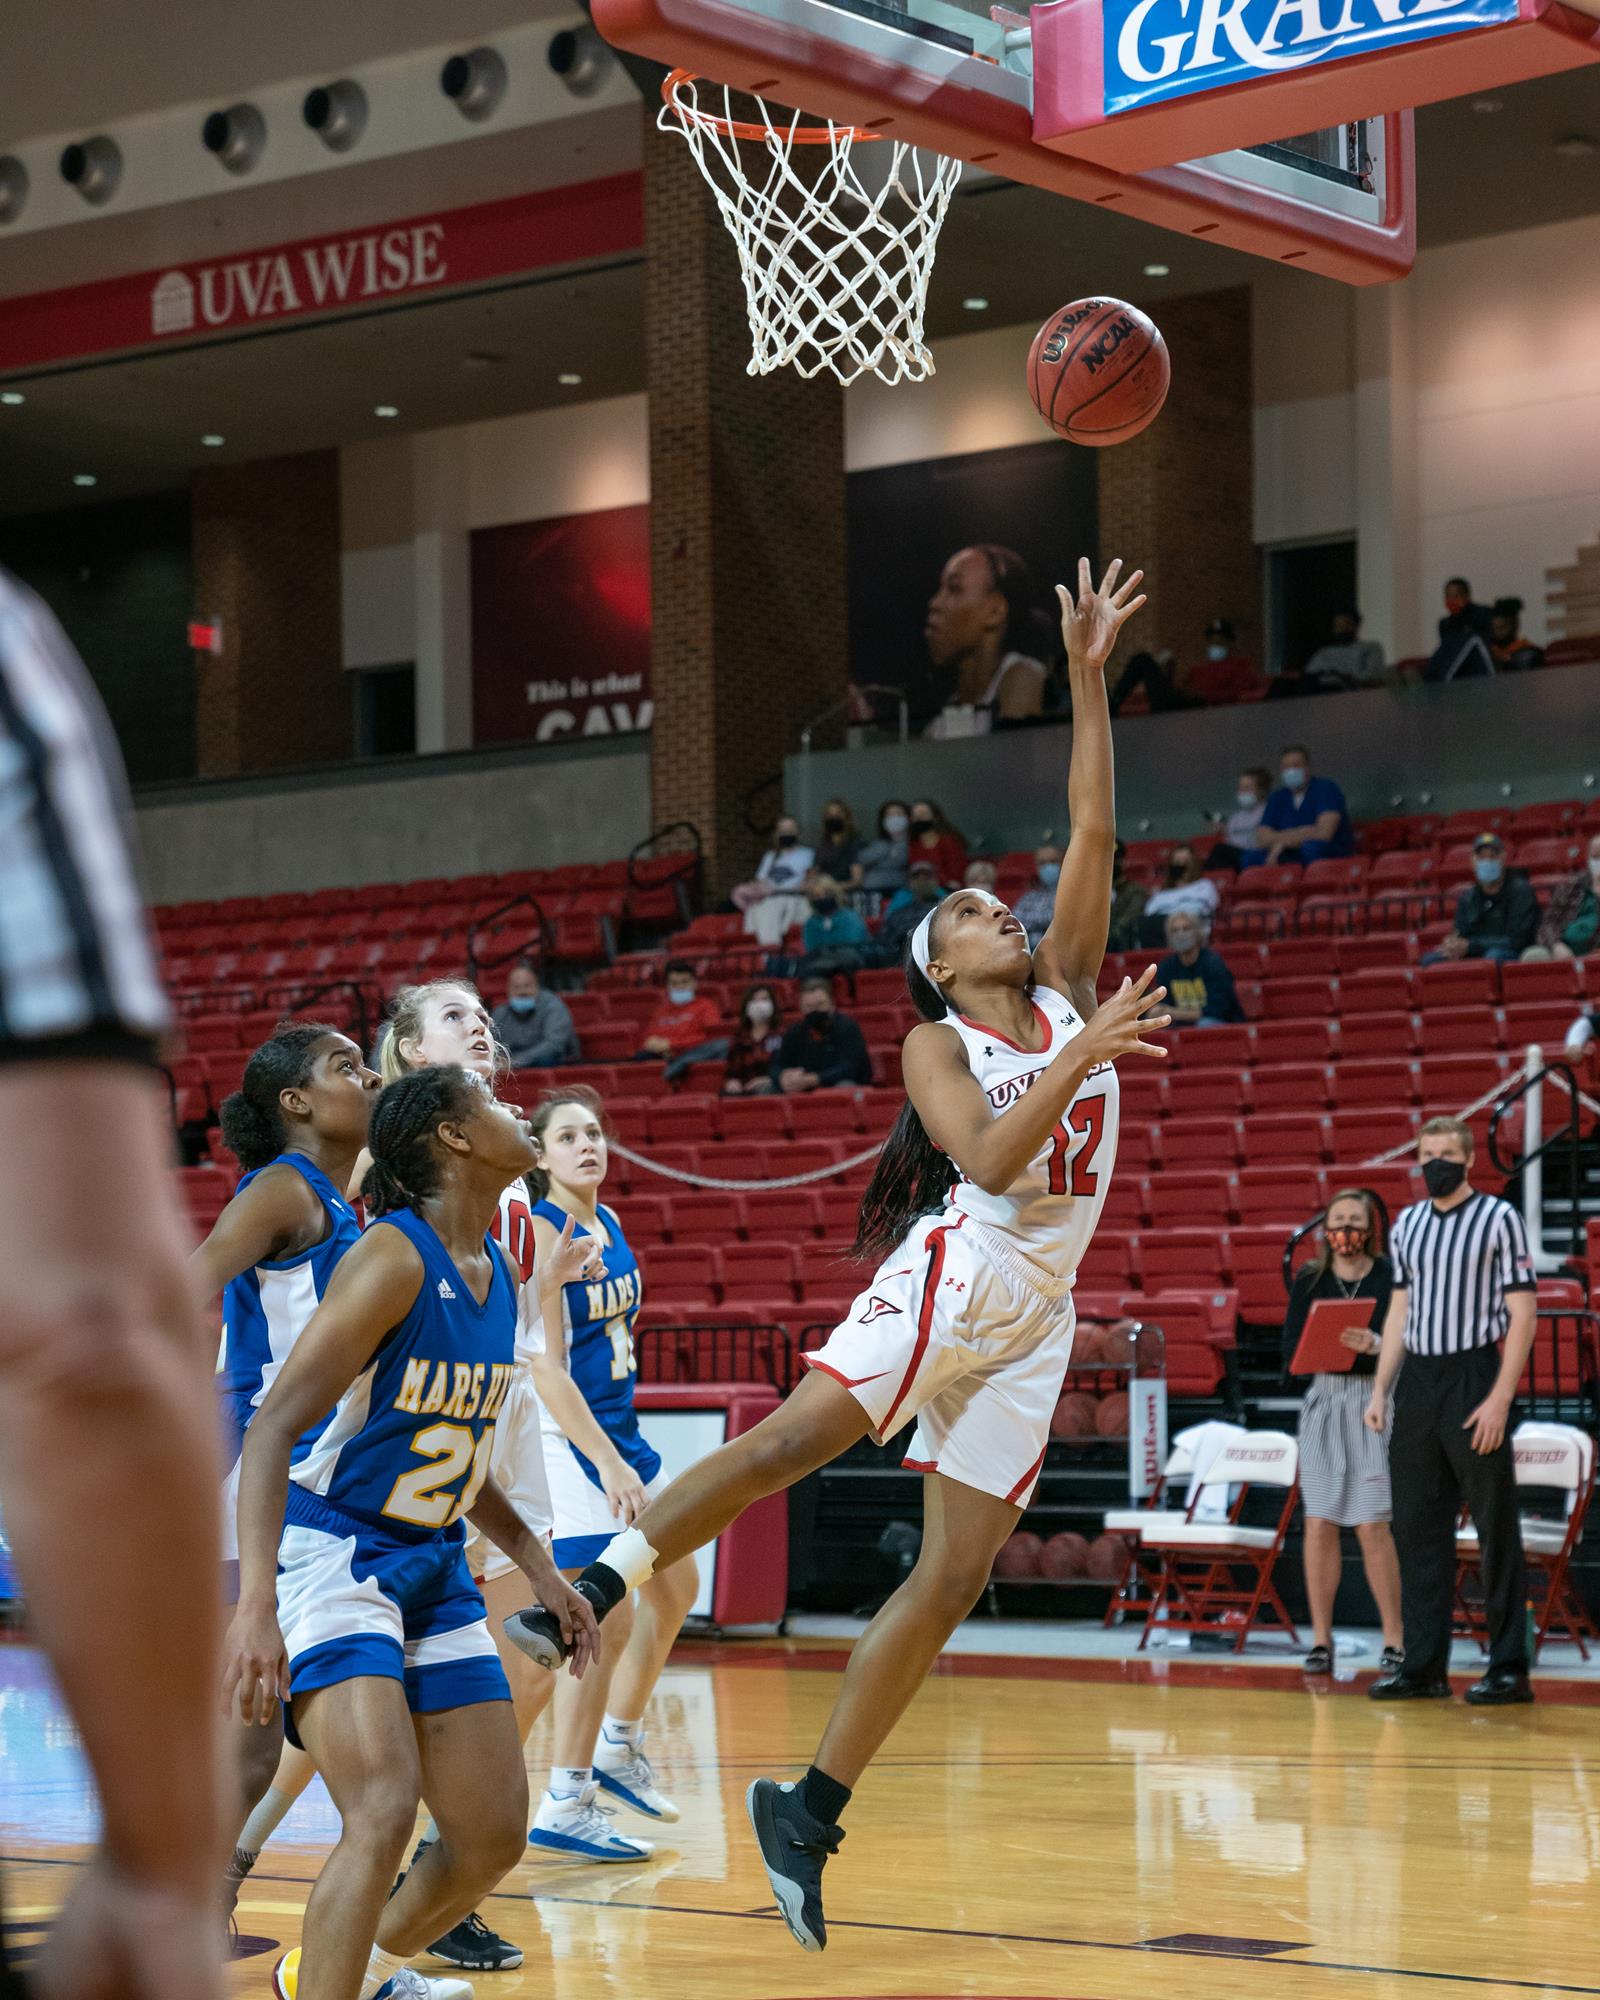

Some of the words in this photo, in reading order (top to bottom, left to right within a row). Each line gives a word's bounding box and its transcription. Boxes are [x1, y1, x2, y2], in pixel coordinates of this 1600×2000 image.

[1118, 0, 1467, 82] GRA
[199, 253, 302, 325] UVA
[303, 223, 448, 305] WISE
[1040, 299, 1112, 364] Wilso
[1082, 316, 1137, 375] NCAA
[527, 678, 568, 704] This
[570, 676, 589, 698] is
[591, 671, 642, 696] what
[1048, 1093, 1106, 1197] 12
[586, 1273, 634, 1321] MARS
[393, 1356, 485, 1420] MARS
[479, 1363, 514, 1419] HI
[380, 1421, 496, 1529] 21
[1144, 1394, 1158, 1485] Wilson
